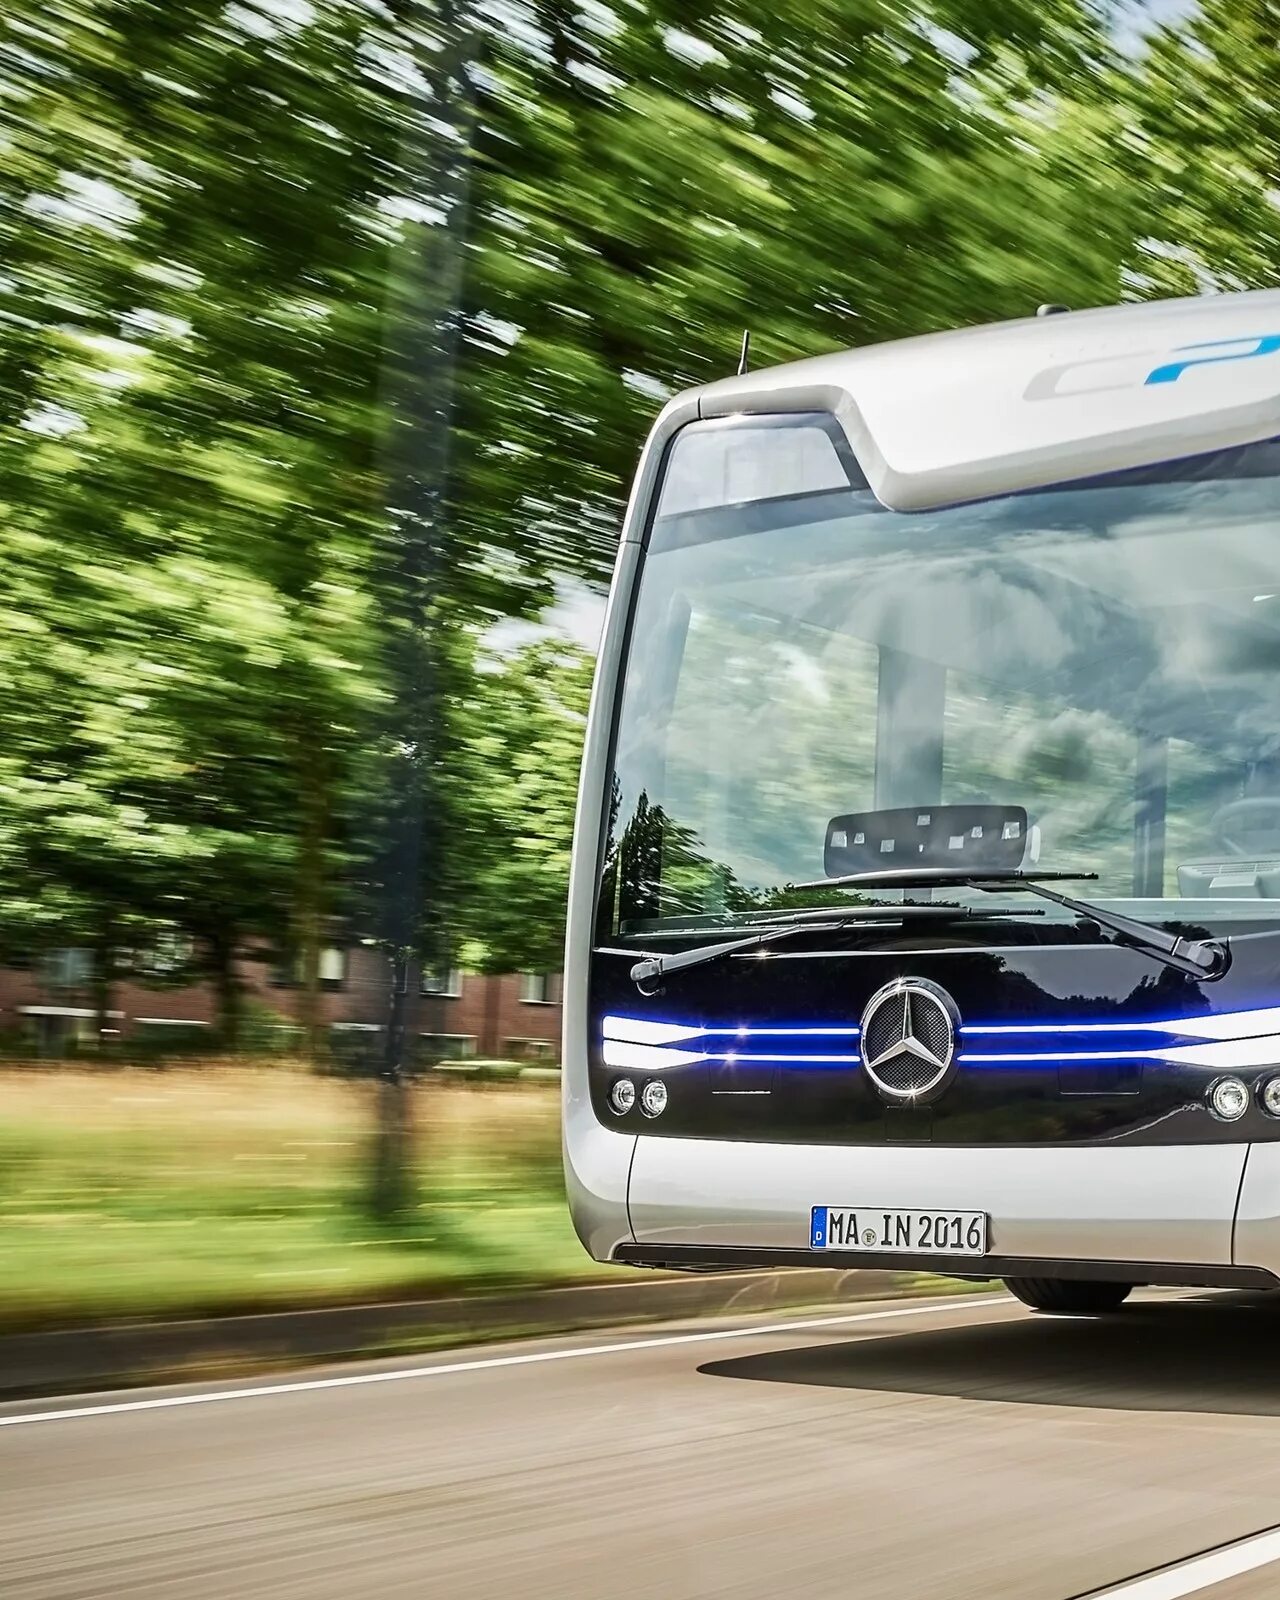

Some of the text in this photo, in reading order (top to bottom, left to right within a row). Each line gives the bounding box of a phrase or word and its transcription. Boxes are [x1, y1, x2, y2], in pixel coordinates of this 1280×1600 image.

[815, 1231, 822, 1240] D
[829, 1213, 981, 1248] MA IN 2016
